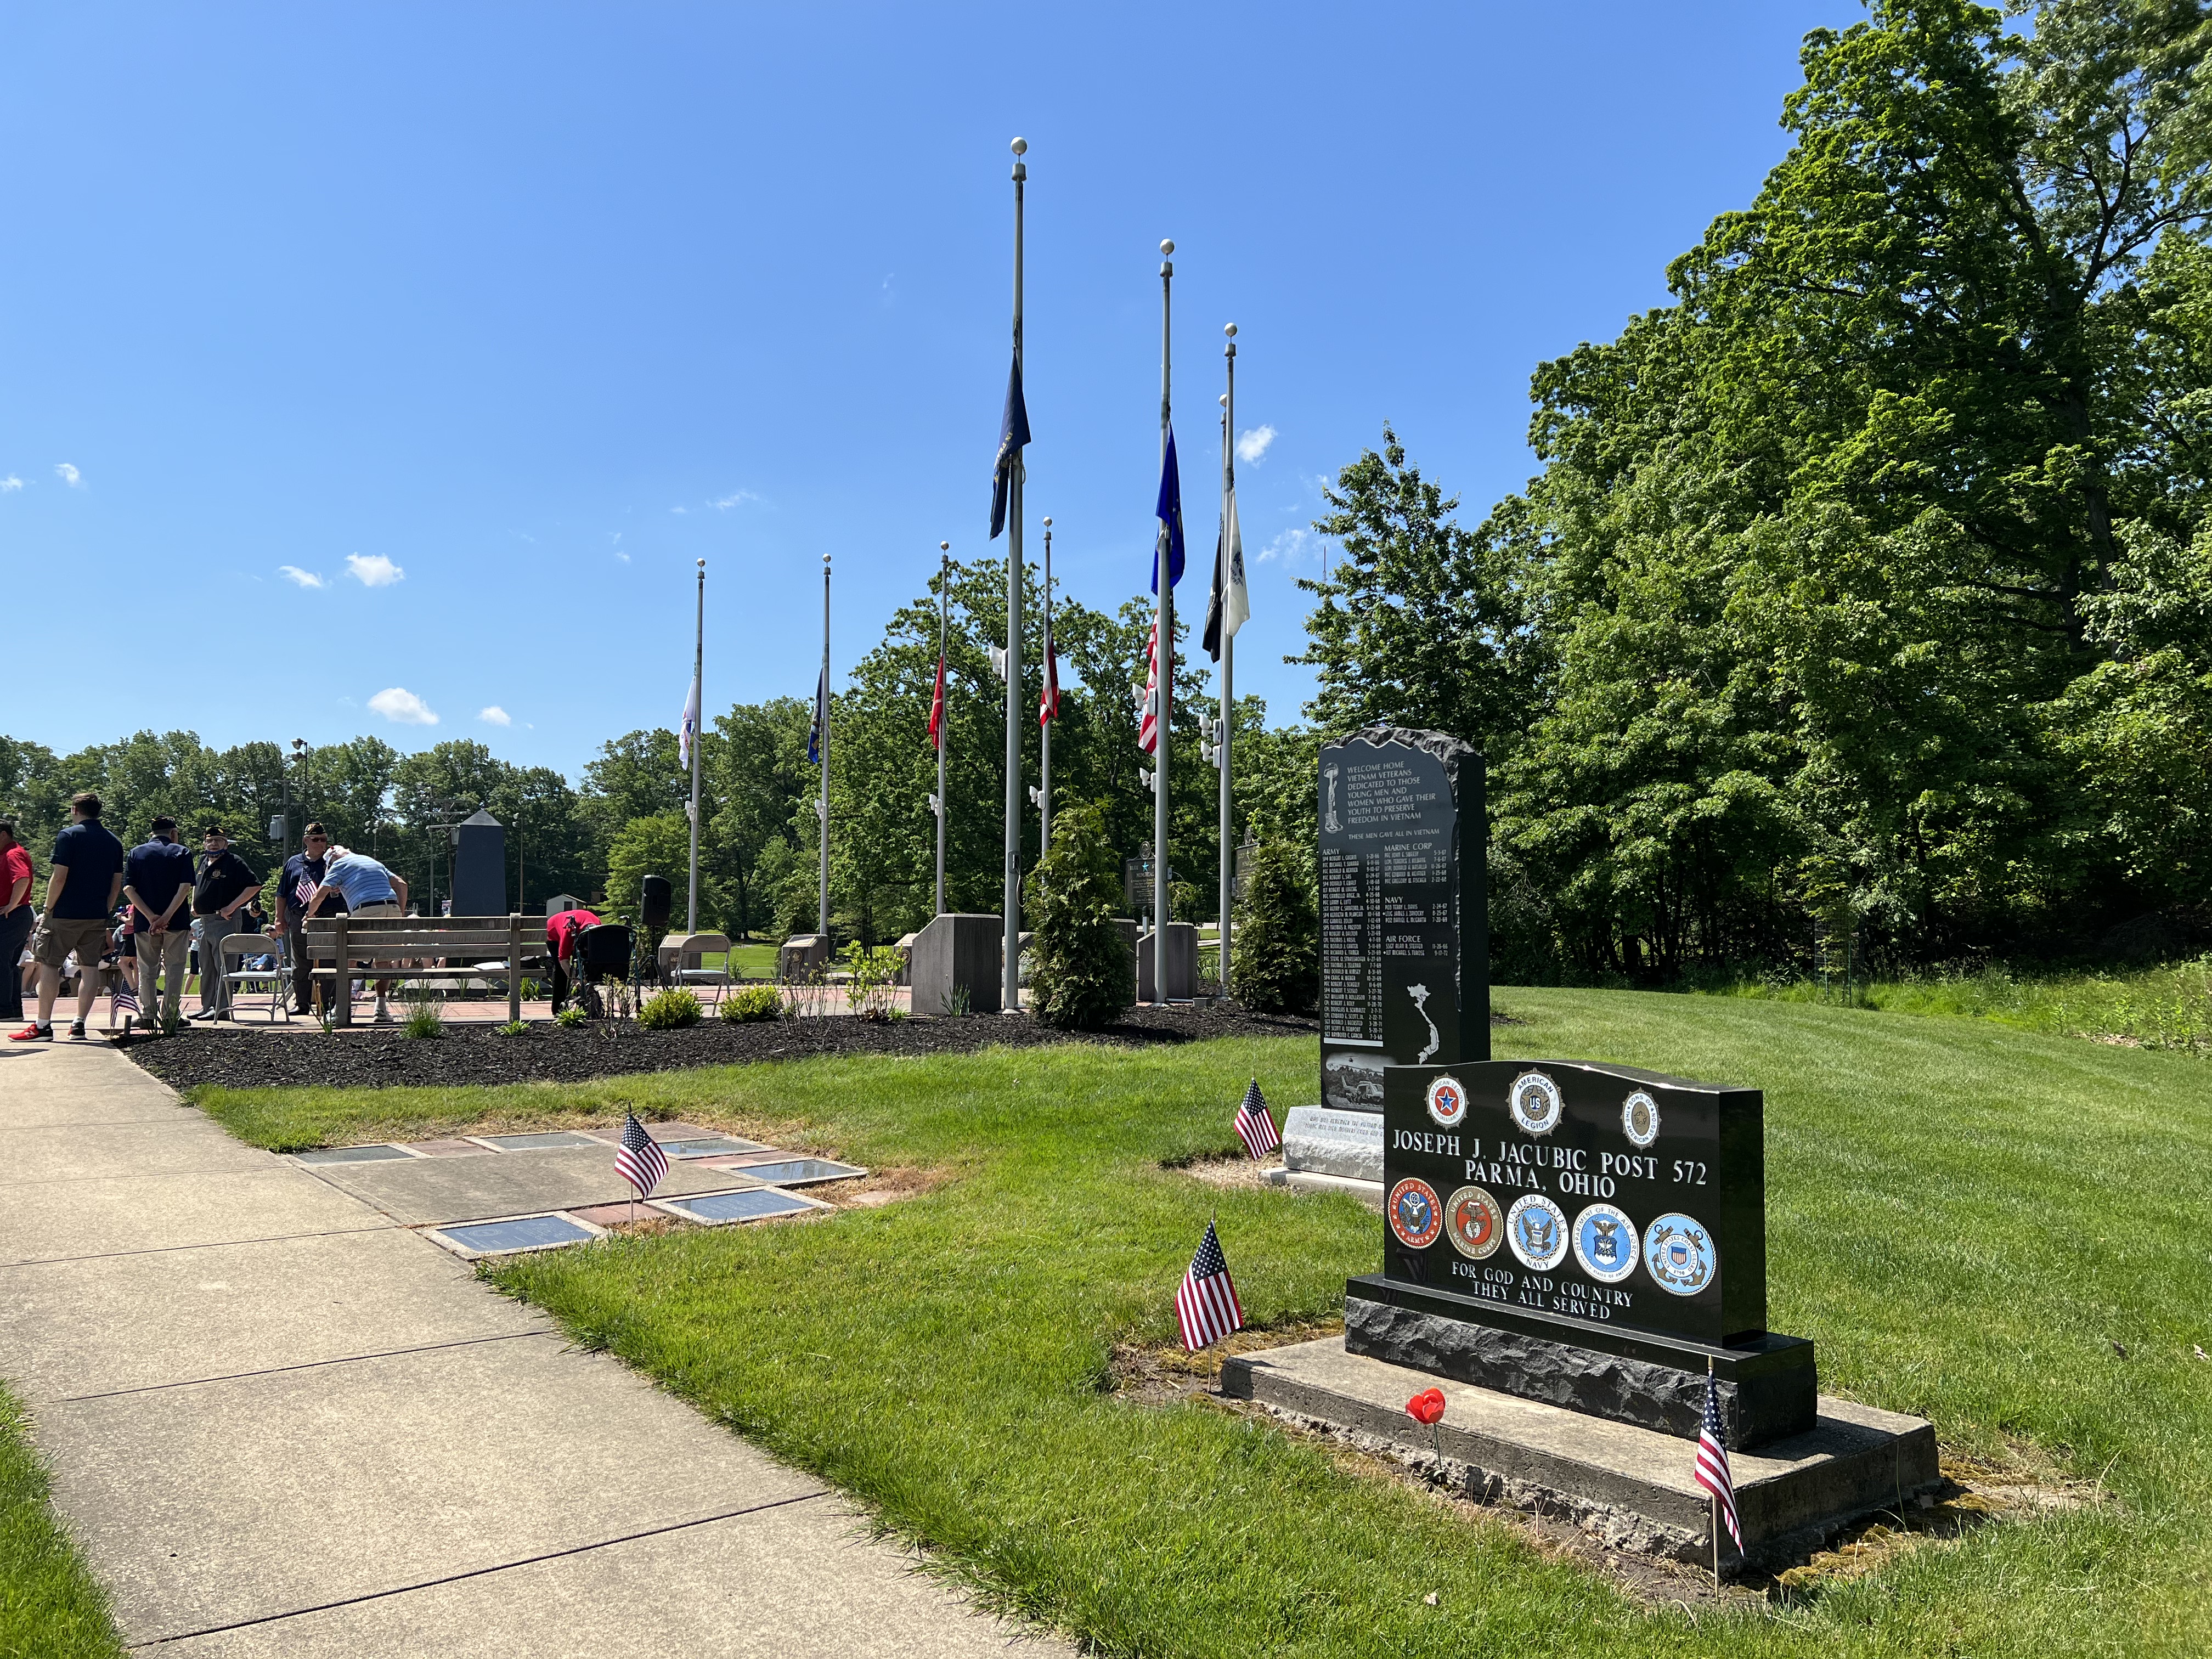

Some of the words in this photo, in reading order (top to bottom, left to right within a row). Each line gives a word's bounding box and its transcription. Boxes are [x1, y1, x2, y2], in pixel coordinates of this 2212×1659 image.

[1347, 764, 1381, 774] WELCOME
[1383, 761, 1404, 770] HOME
[1347, 773, 1376, 782] VIETNAM
[1379, 769, 1412, 778] VETERANS
[1348, 781, 1384, 790] DEDICATED
[1398, 777, 1420, 785] THOSE
[1348, 790, 1372, 799] YOUNG
[1391, 787, 1407, 795] AND
[1347, 799, 1374, 807] WOMEN
[1376, 797, 1393, 805] WHO
[1384, 804, 1415, 812] PRESERVE
[1348, 816, 1379, 824] FREEDOM
[1391, 812, 1421, 821] VIETNAM
[1431, 1081, 1449, 1101] AMERICAN
[1452, 1083, 1463, 1104] LEGION
[1518, 1076, 1553, 1092] AMERICAN
[1530, 1097, 1541, 1108] US
[1629, 1095, 1643, 1105] SONS
[1646, 1099, 1653, 1107] OF
[1521, 1118, 1549, 1128] LEGION
[1627, 1125, 1649, 1142] AMERICAN
[1393, 1130, 1460, 1156] JOSEPH
[1472, 1138, 1486, 1159] J.
[1499, 1141, 1587, 1171] JACUBIC
[1600, 1152, 1658, 1180] POST
[1673, 1160, 1706, 1185] 572
[1465, 1159, 1547, 1193] PARMA,
[1559, 1172, 1615, 1198] OHIO
[1393, 1183, 1414, 1203] UNITED
[1418, 1185, 1437, 1210] STATES
[1451, 1192, 1474, 1212] UNITED
[1477, 1193, 1498, 1220] STATES
[1508, 1196, 1536, 1224] UNITED
[1542, 1198, 1567, 1233] STATES
[1576, 1210, 1593, 1251] DEPARTMENT
[1608, 1209, 1619, 1217] THE
[1621, 1219, 1631, 1229] AIR
[1406, 1235, 1424, 1244] ARMY
[1453, 1232, 1475, 1254] MARINE
[1478, 1238, 1496, 1254] CORPS
[1664, 1236, 1680, 1246] STATES
[1681, 1238, 1695, 1251] COAST
[1688, 1254, 1696, 1272] GUARD
[1526, 1258, 1549, 1269] NAVY
[1581, 1255, 1592, 1269] UNITED
[1616, 1263, 1631, 1277] AMERICA
[1452, 1262, 1476, 1278] FOR
[1485, 1268, 1514, 1285] GOD
[1521, 1276, 1553, 1292] AND
[1561, 1282, 1633, 1307] COUNTRY
[1472, 1281, 1509, 1300] THEY
[1518, 1290, 1544, 1307] ALL
[1553, 1296, 1610, 1319] SERVED
